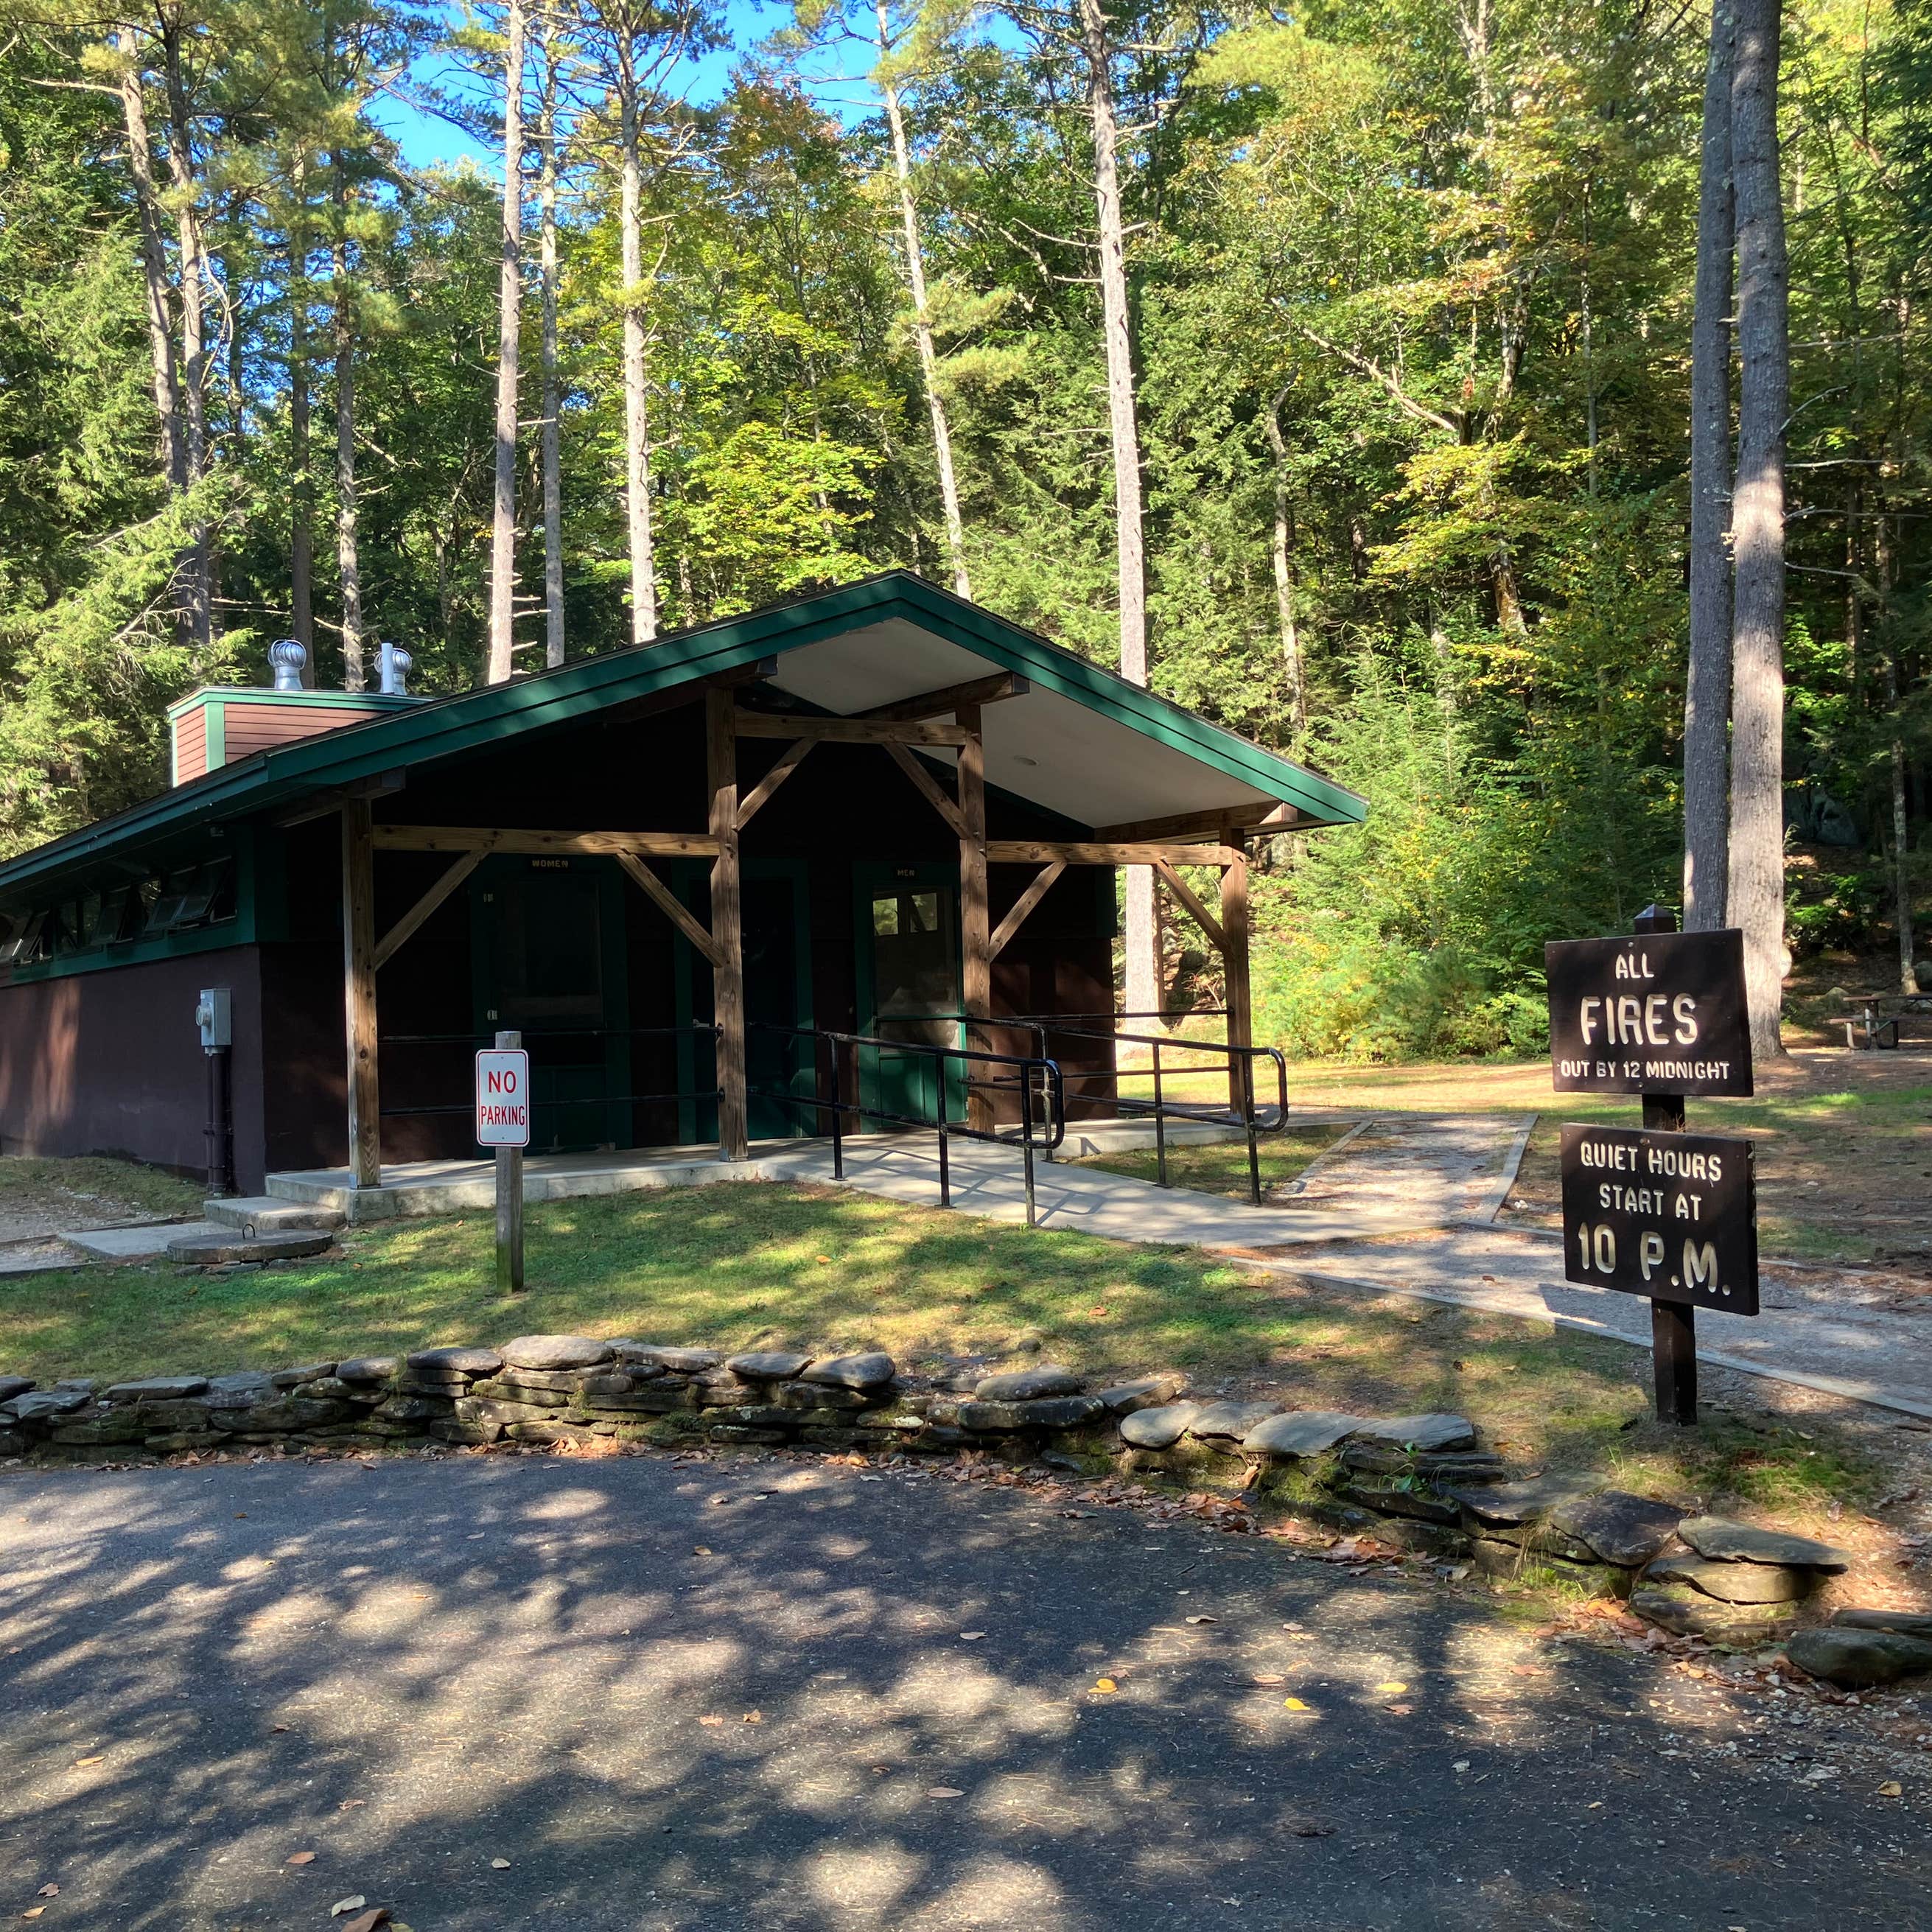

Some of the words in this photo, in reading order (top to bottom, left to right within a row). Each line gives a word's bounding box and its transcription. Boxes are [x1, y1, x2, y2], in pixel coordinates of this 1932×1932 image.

[1615, 953, 1654, 979] ALL
[1581, 993, 1698, 1046] FIRES
[489, 1071, 517, 1093] NO
[1561, 1060, 1590, 1077] OUT
[1596, 1060, 1617, 1078] BY
[1623, 1060, 1641, 1078] 12
[1645, 1061, 1729, 1079] MIDNIGHT
[480, 1105, 525, 1126] PARKING
[1581, 1141, 1638, 1172] QUIET
[1648, 1147, 1722, 1182] HOURS
[1599, 1183, 1664, 1216] START
[1676, 1193, 1702, 1221] AT
[1578, 1222, 1617, 1274] 10
[1640, 1231, 1731, 1295] P.M.
